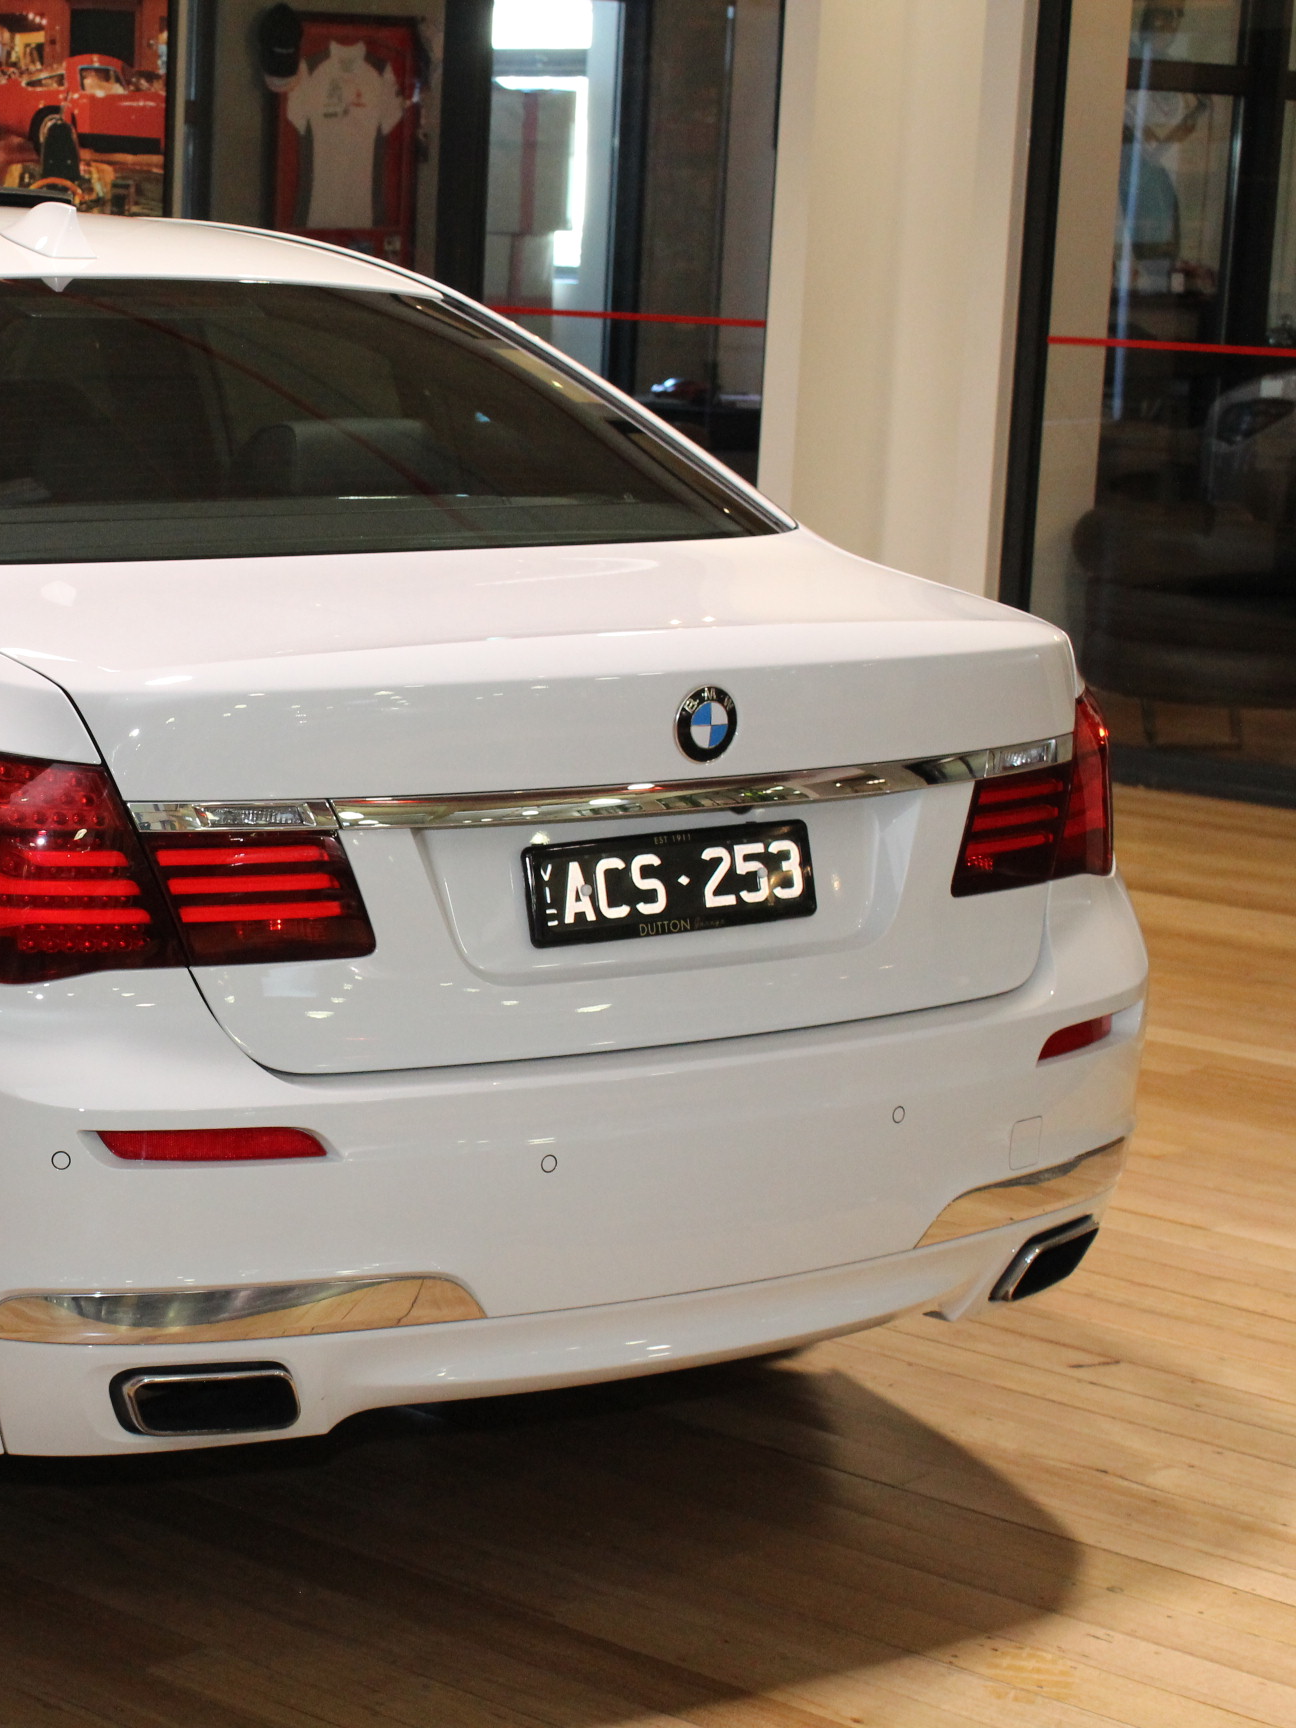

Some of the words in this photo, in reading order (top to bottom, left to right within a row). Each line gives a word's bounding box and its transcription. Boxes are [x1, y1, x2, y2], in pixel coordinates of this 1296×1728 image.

[684, 687, 734, 714] BMW
[654, 835, 668, 846] EST
[671, 833, 691, 843] 1911
[639, 917, 691, 936] DUTTON
